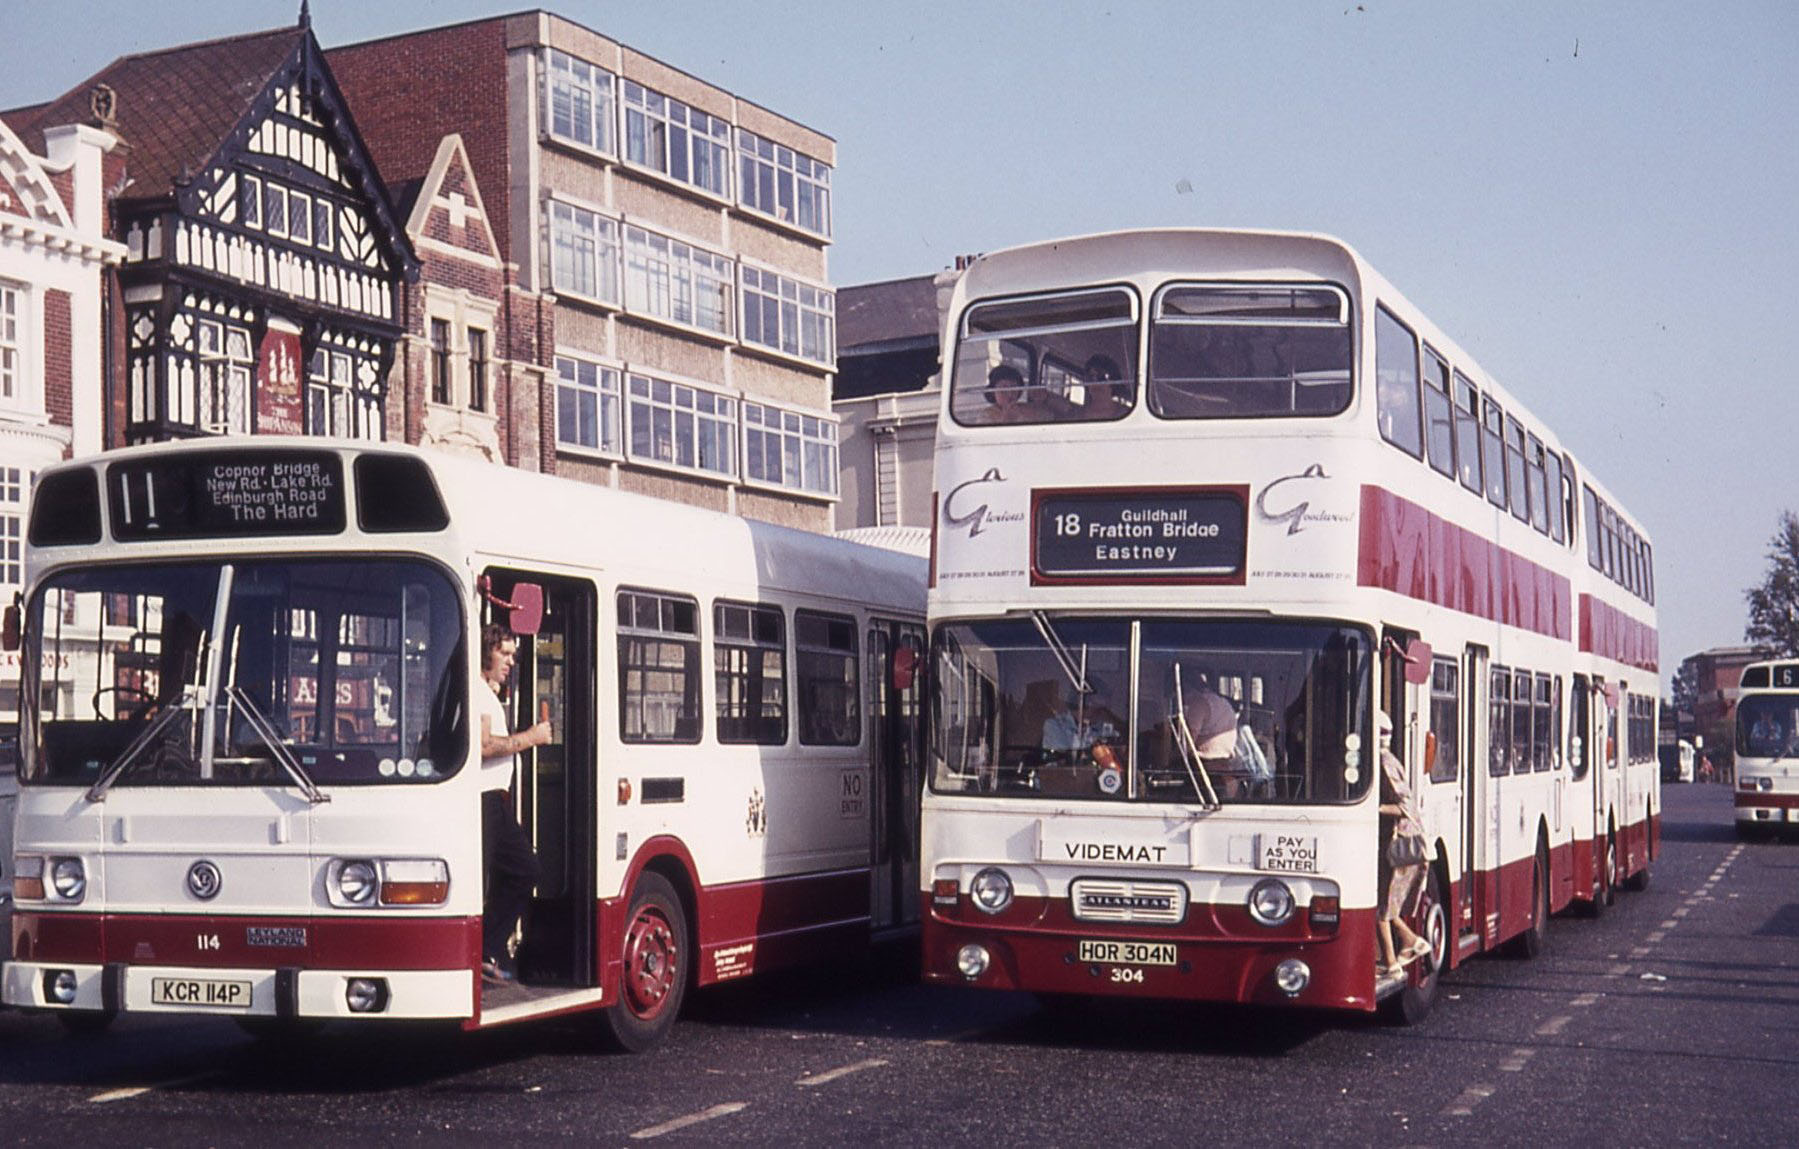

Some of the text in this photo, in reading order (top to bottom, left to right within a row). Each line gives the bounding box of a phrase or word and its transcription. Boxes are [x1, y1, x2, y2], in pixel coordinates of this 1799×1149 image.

[214, 463, 320, 479] Copnor Bridge
[206, 473, 333, 491] New Rd. Lake Rd.
[121, 472, 156, 524] 11
[213, 488, 326, 505] Edinburgh Road
[943, 467, 1025, 538] Glorious
[231, 502, 318, 520] The Hard
[1121, 509, 1188, 522] Guildhall
[1055, 513, 1081, 536] 18
[1089, 523, 1153, 538] Fratton
[1096, 545, 1177, 561] Eastney
[1783, 669, 1793, 685] 6
[843, 774, 861, 796] NO
[841, 800, 863, 813] ENTRY
[1278, 836, 1304, 847] PAY
[1065, 843, 1167, 863] VIDEMAT
[1266, 847, 1316, 860] AS YOU
[1268, 858, 1312, 870] ENTER
[1088, 897, 1169, 908] ATLANTEAN
[247, 928, 305, 937] LEYLAND
[247, 936, 305, 945] NATIONAL
[197, 935, 220, 950] 114
[1081, 942, 1175, 963] HOR 304N
[1111, 968, 1144, 983] 304
[163, 980, 241, 1003] KCR 114P
